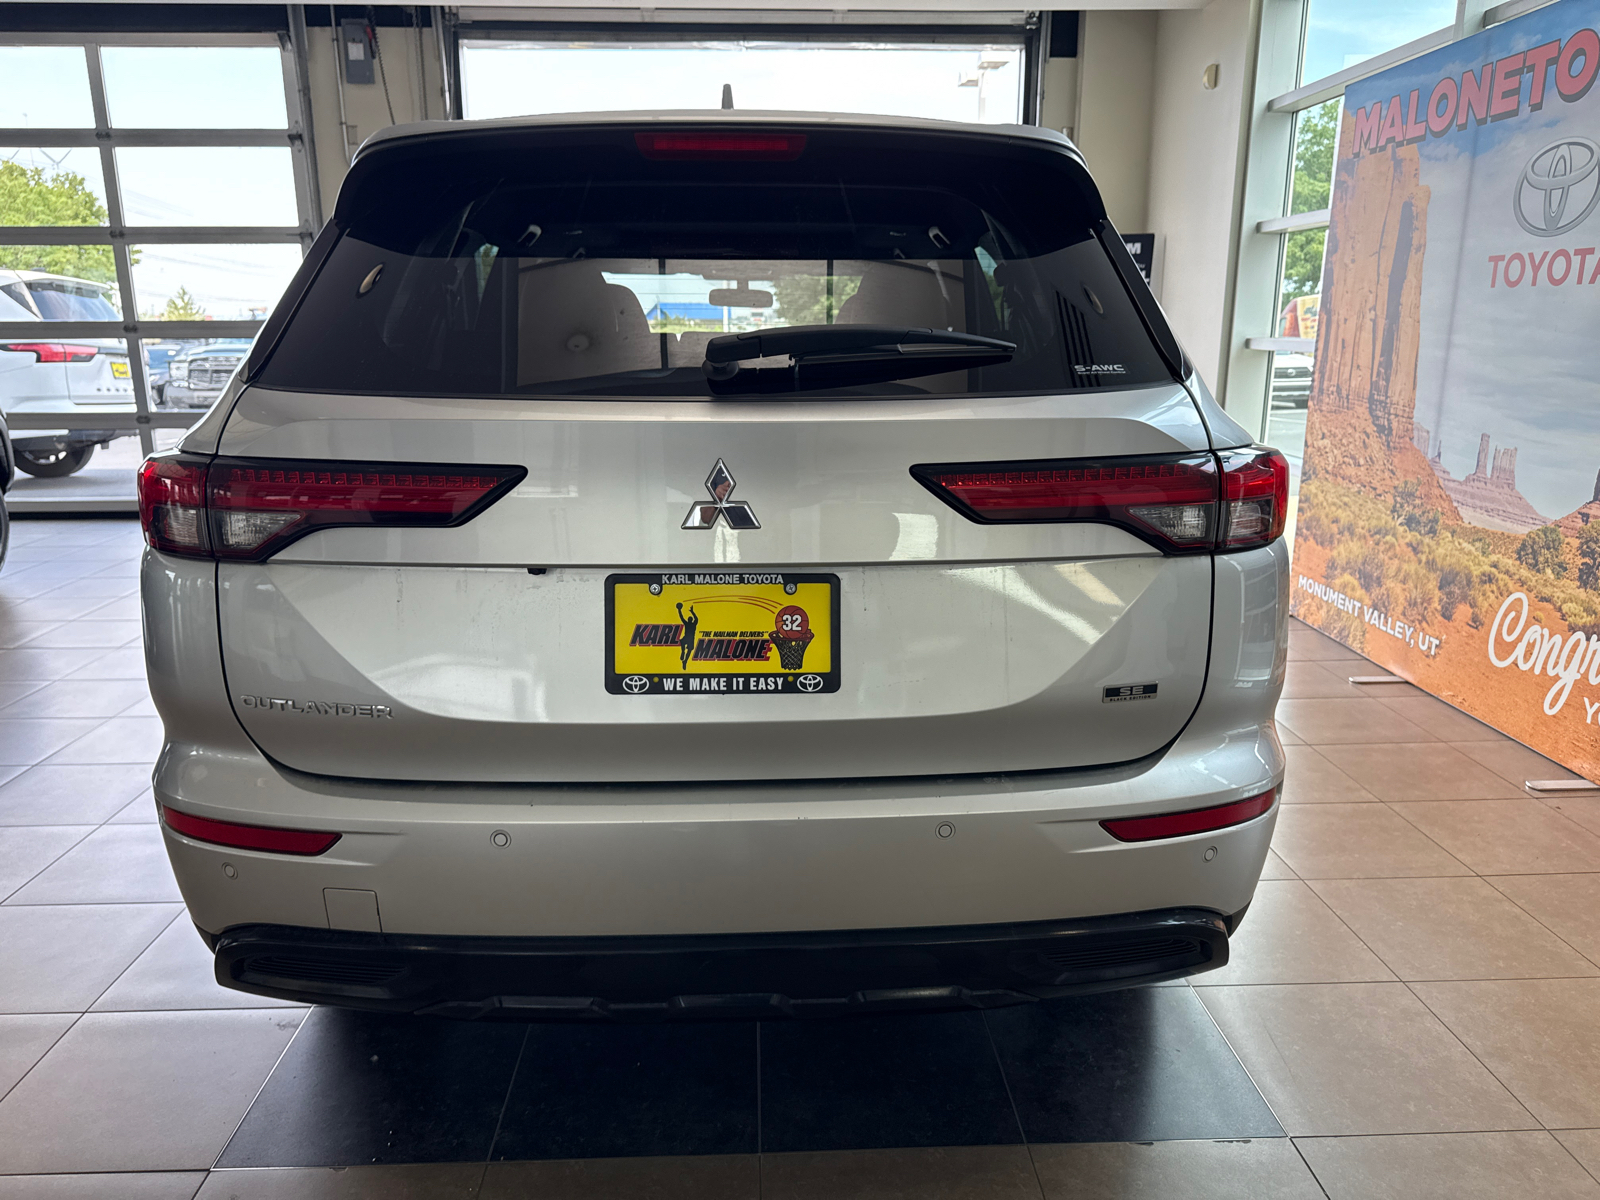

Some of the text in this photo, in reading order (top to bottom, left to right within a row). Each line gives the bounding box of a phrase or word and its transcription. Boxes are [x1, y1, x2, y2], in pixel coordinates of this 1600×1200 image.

[1074, 364, 1125, 372] S-AWC
[661, 574, 784, 584] KARL MALONE TOYOTA
[782, 614, 802, 631] 32
[1298, 574, 1440, 656] MONUMENT VALLEY, UT
[629, 624, 685, 647] KARL
[713, 630, 739, 638] MAILMAN
[692, 638, 773, 662] MALONE
[663, 677, 784, 691] WE MAKE IT EASY
[1119, 685, 1144, 696] SE
[241, 694, 394, 719] OUTLANDER
